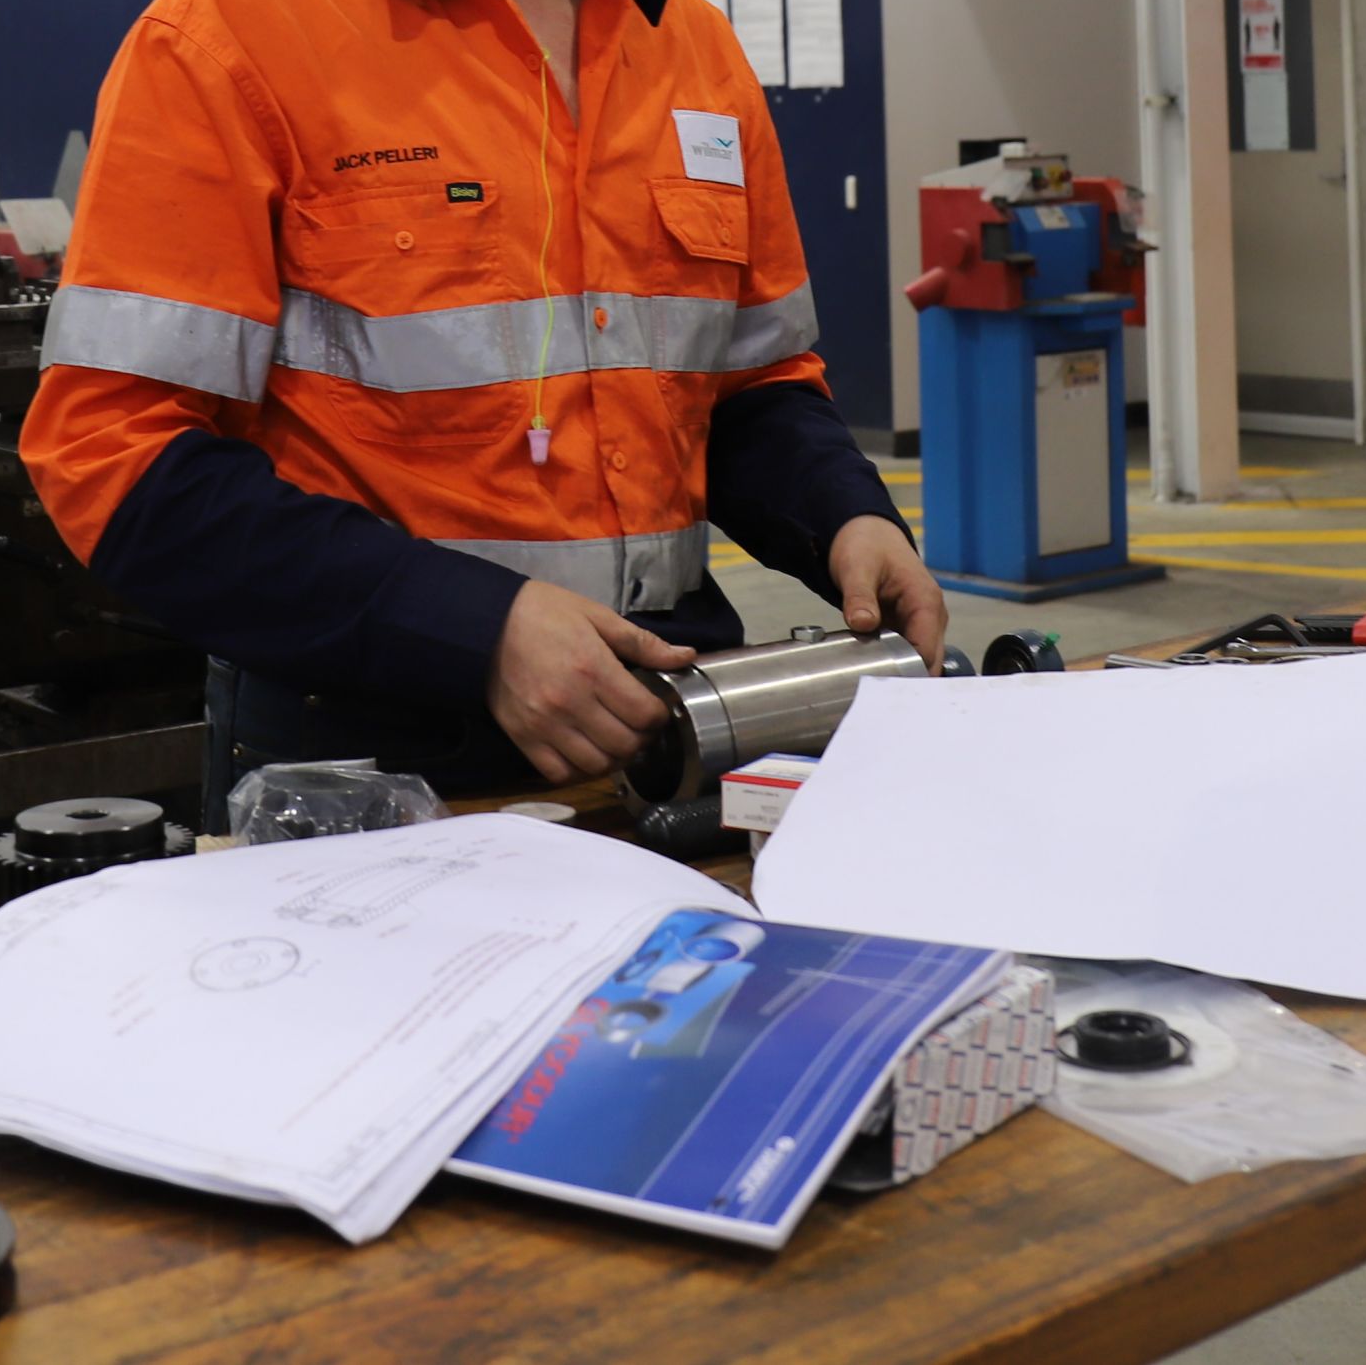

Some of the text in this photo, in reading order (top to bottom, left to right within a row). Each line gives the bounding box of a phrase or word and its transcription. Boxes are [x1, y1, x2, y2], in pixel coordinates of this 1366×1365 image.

[333, 147, 438, 172] JACK PELLERI
[450, 187, 479, 199] Bisley
